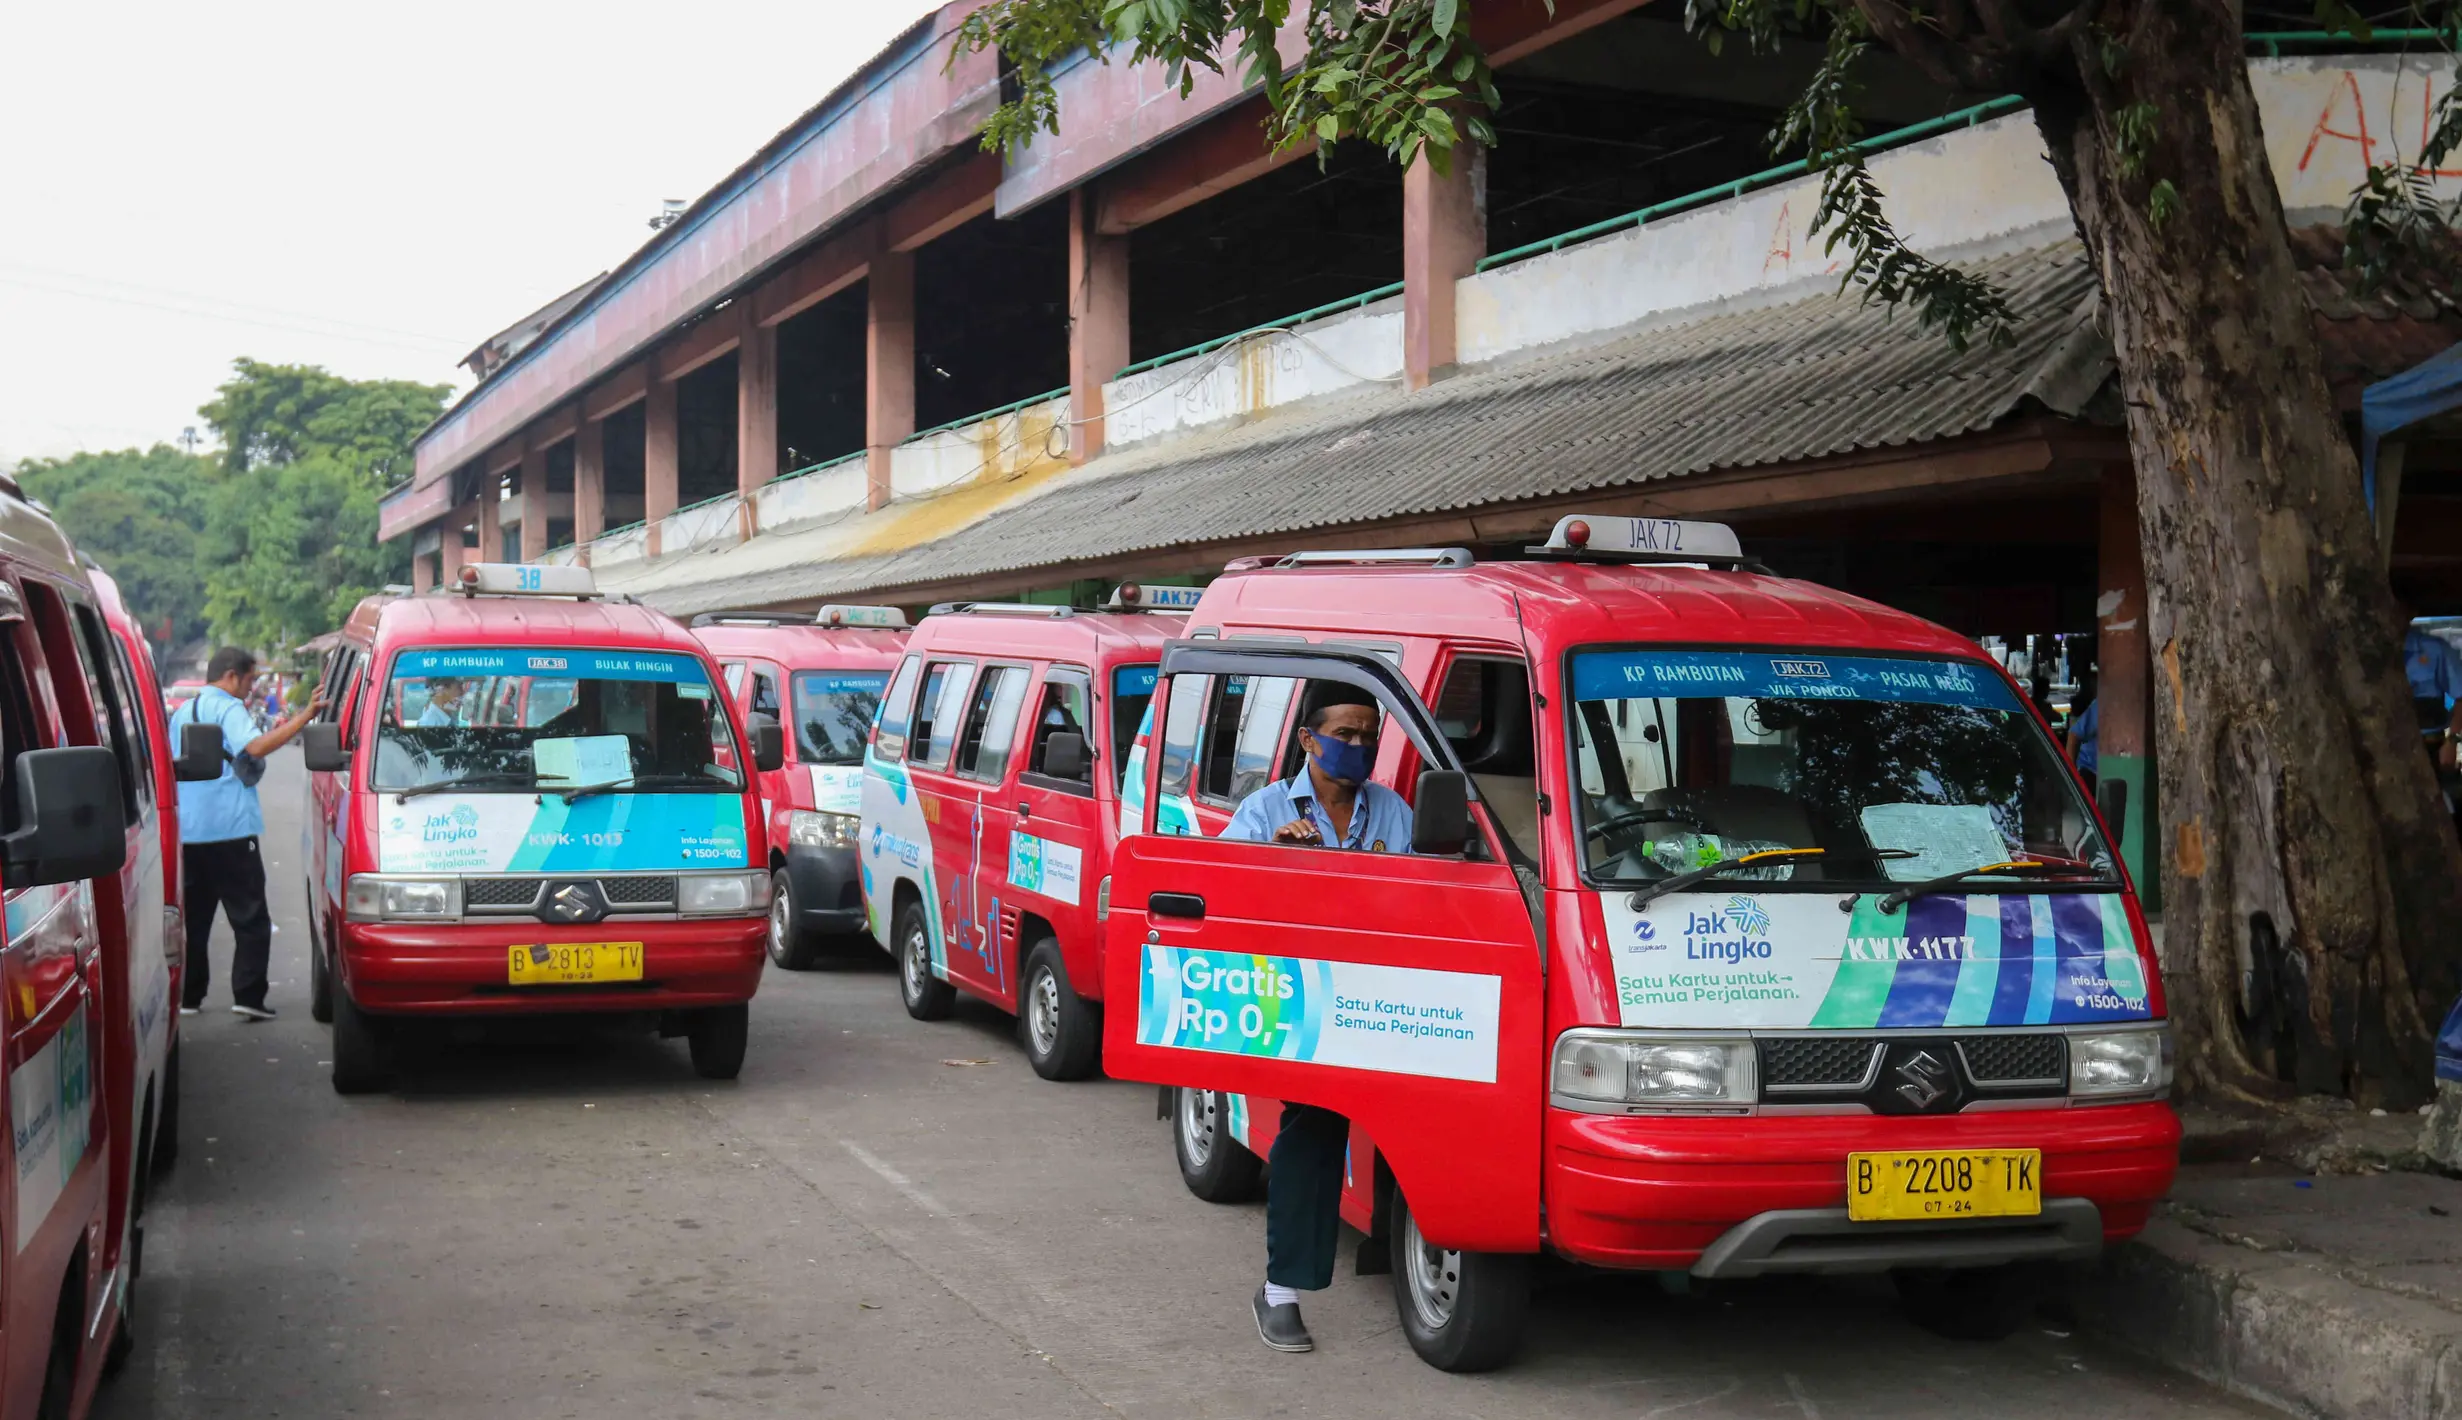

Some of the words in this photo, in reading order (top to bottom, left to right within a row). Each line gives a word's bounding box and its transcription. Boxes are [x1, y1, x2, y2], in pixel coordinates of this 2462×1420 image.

[1630, 519, 1658, 549] JAK
[1662, 521, 1682, 550] 72
[516, 567, 541, 590] 38
[423, 657, 437, 668] KP
[444, 657, 504, 667] RAMBUTAN
[595, 660, 630, 670] BULAK
[636, 662, 674, 673] RINGIN
[1142, 675, 1155, 685] KP
[1623, 666, 1645, 681] KP
[1653, 665, 1746, 681] RAMBUTAN
[1880, 671, 1931, 689] PASAR
[1768, 684, 1795, 696] VIA
[1801, 685, 1860, 698] PONCOL
[424, 814, 451, 828] Jak
[423, 829, 477, 842] Lingko
[444, 846, 477, 857] untuk
[694, 848, 742, 858] 1500-102
[1018, 834, 1040, 858] Gratis
[1683, 912, 1727, 935] Jak
[1629, 943, 1667, 952] transjakarta
[1688, 936, 1772, 964] Lingko
[514, 950, 525, 971] B
[548, 948, 594, 969] 2813
[618, 946, 639, 968] TV
[1181, 956, 1294, 999] Gratis
[1620, 976, 1663, 989] Satu
[1669, 973, 1719, 987] Kartu
[1726, 970, 1778, 985] untuk
[2071, 976, 2090, 986] Info
[2092, 976, 2132, 988] Layanan
[1622, 990, 1688, 1005] Semua
[1694, 986, 1799, 1004] Perjalanan.
[2088, 995, 2145, 1011] 1500-102
[1336, 996, 1370, 1011] Satu
[1375, 1000, 1415, 1016] Kartu
[1420, 1007, 1464, 1020] untuk
[1180, 997, 1228, 1042] Rp
[1335, 1014, 1386, 1031] Semua
[1391, 1020, 1474, 1040] Perjalanan
[1858, 1159, 1872, 1194] B
[1905, 1157, 1972, 1193] 2208
[2002, 1155, 2033, 1191] TK
